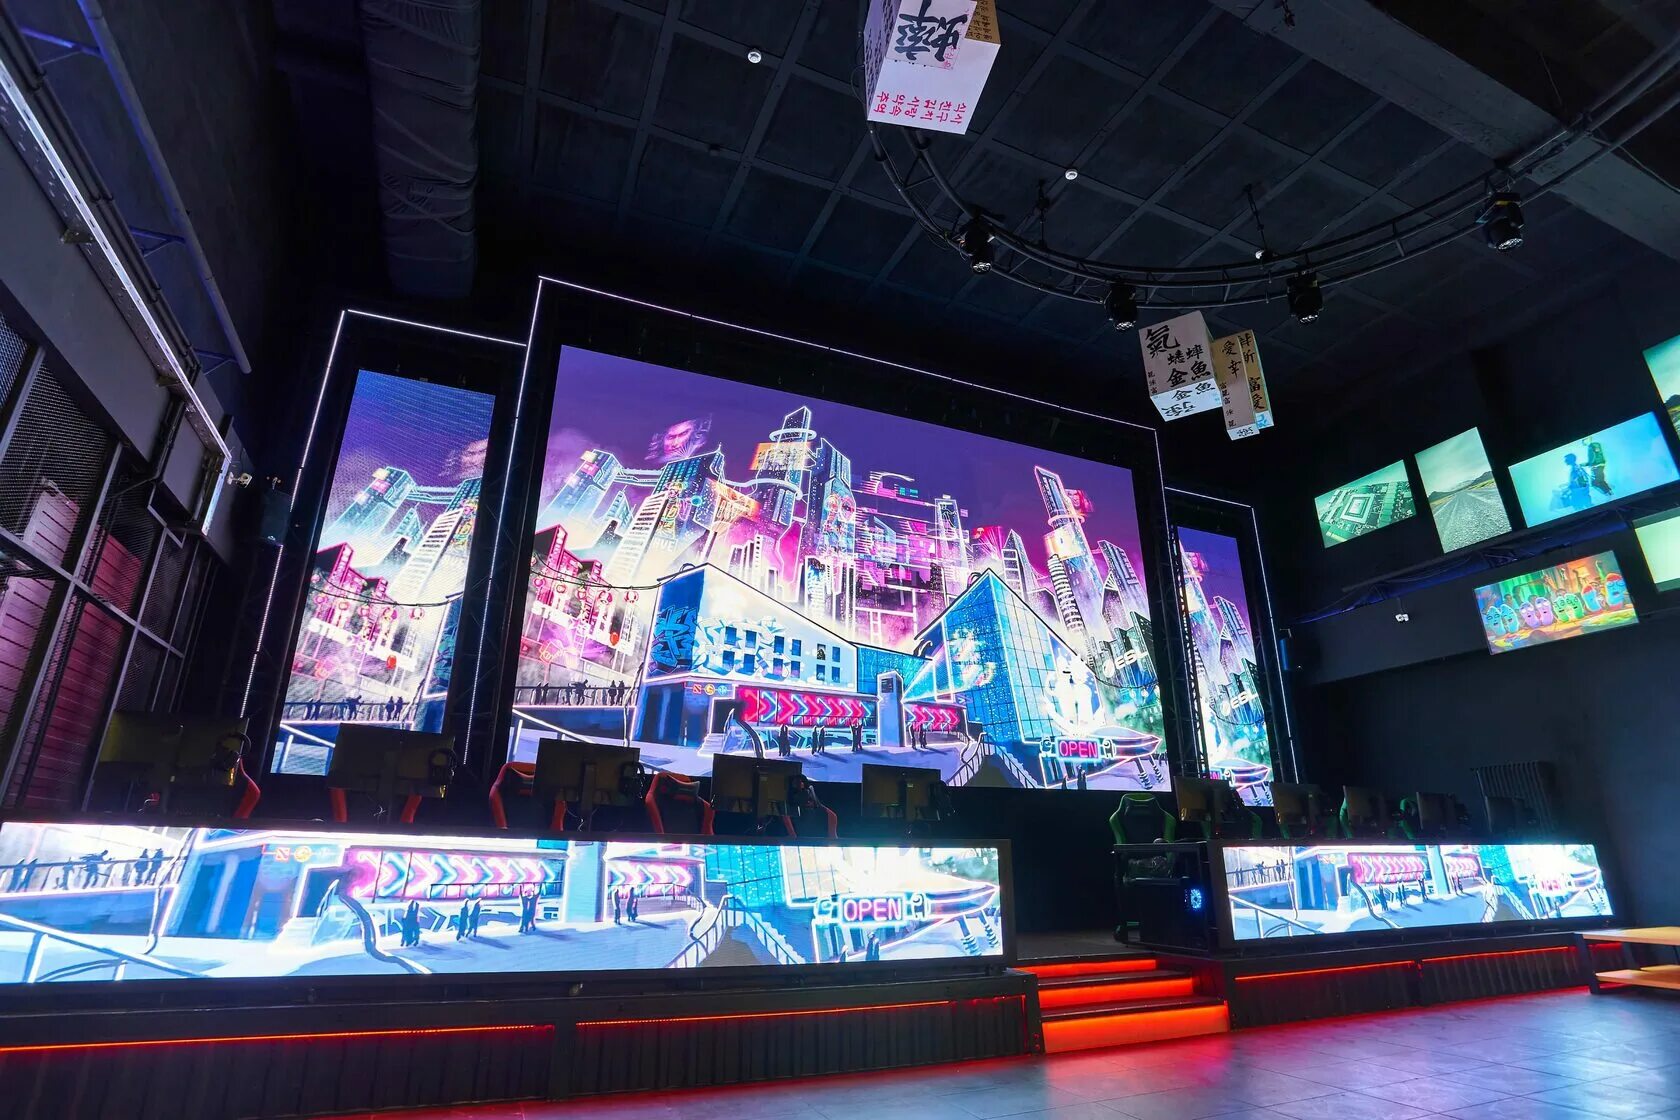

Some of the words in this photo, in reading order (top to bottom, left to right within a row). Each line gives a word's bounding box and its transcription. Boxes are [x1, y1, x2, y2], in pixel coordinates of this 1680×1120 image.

[873, 91, 890, 114] 추억
[889, 94, 906, 116] 약속
[905, 96, 920, 118] 사랑
[920, 99, 937, 120] 김치
[936, 100, 952, 122] 친구
[1145, 325, 1180, 358] 氣
[1167, 360, 1211, 388] 金魚
[1115, 649, 1149, 670] ESL
[1059, 740, 1098, 758] OPEN
[843, 898, 902, 922] OPEN
